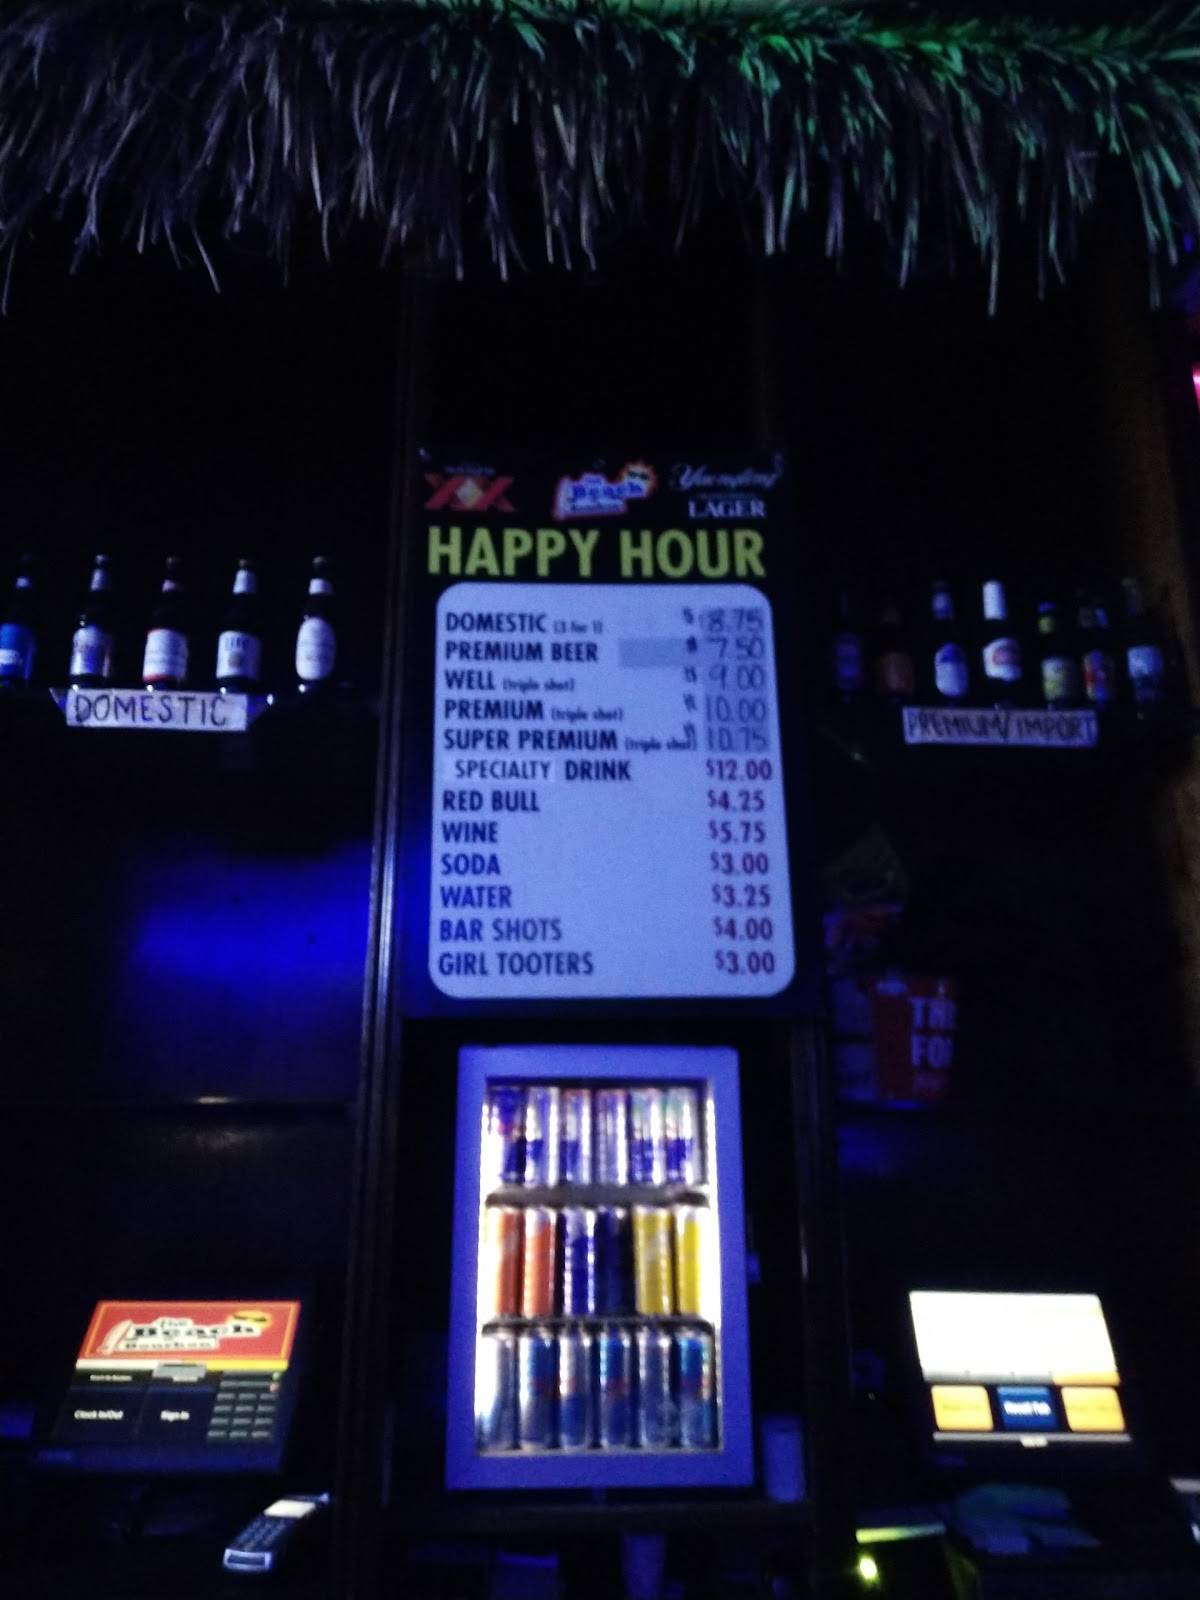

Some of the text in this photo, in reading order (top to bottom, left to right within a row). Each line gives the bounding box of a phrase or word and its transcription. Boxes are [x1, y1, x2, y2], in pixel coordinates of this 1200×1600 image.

[688, 500, 766, 519] LAGER
[427, 526, 766, 578] HAPPY HOUR
[445, 612, 546, 634] DOMESTIC
[445, 641, 543, 662] PREMIUM
[551, 641, 598, 662] BEER
[445, 670, 496, 691] WELL
[74, 694, 228, 727] DOMESTIC
[444, 699, 544, 721] PREMIUM
[444, 729, 509, 751] SUPER
[518, 729, 618, 751] PREMIUM
[455, 758, 773, 782] SPECIALTY DRINK $12.00
[443, 789, 765, 813] RED BULL $4.25
[442, 820, 766, 844] WINE $5.75
[441, 851, 769, 876] SODA $3.00
[440, 883, 771, 909] WATER $3.25
[439, 916, 774, 942] BAR SHOTS $4.00
[438, 950, 776, 976] GIRL TOOTERS $3.00
